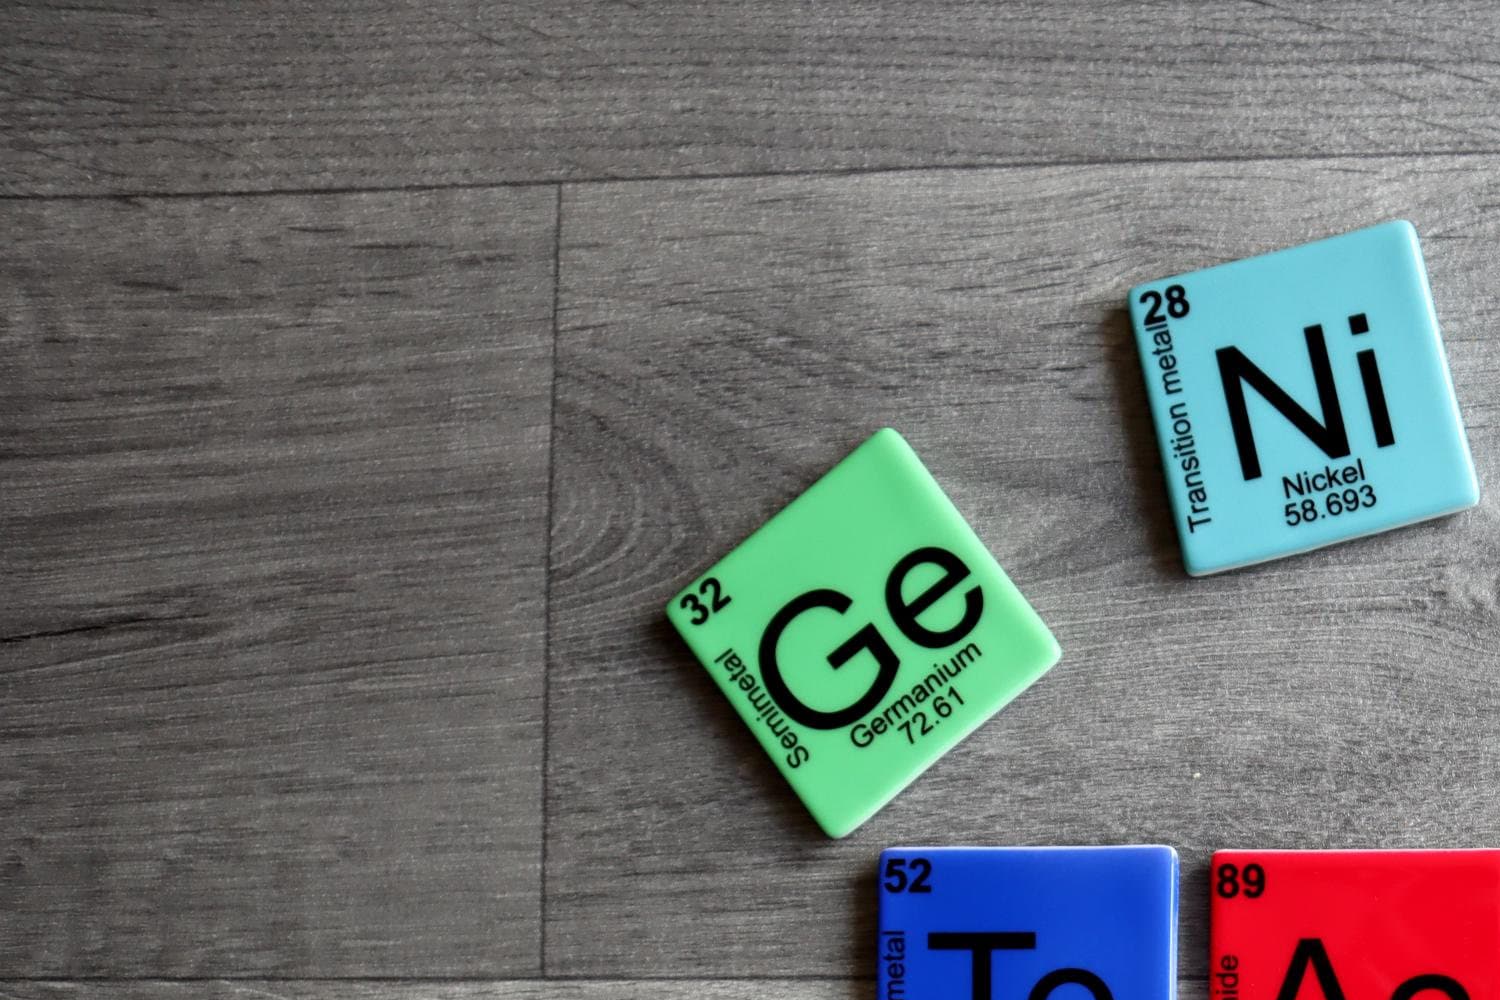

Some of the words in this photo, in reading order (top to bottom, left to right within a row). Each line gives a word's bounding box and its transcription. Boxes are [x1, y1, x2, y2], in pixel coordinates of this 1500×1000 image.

[1139, 284, 1190, 327] 28
[1145, 323, 1184, 396] metal
[1214, 312, 1396, 482] Ni
[1169, 402, 1212, 534] Transition
[1281, 457, 1366, 500] Nickel
[1284, 484, 1377, 527] 58.693
[680, 577, 733, 626] 32
[757, 546, 985, 731] Ge
[714, 647, 810, 769] Semimetal
[849, 642, 982, 749] Germanium
[897, 686, 965, 745] 72.61
[884, 857, 933, 894] 52
[1216, 863, 1266, 900] 89
